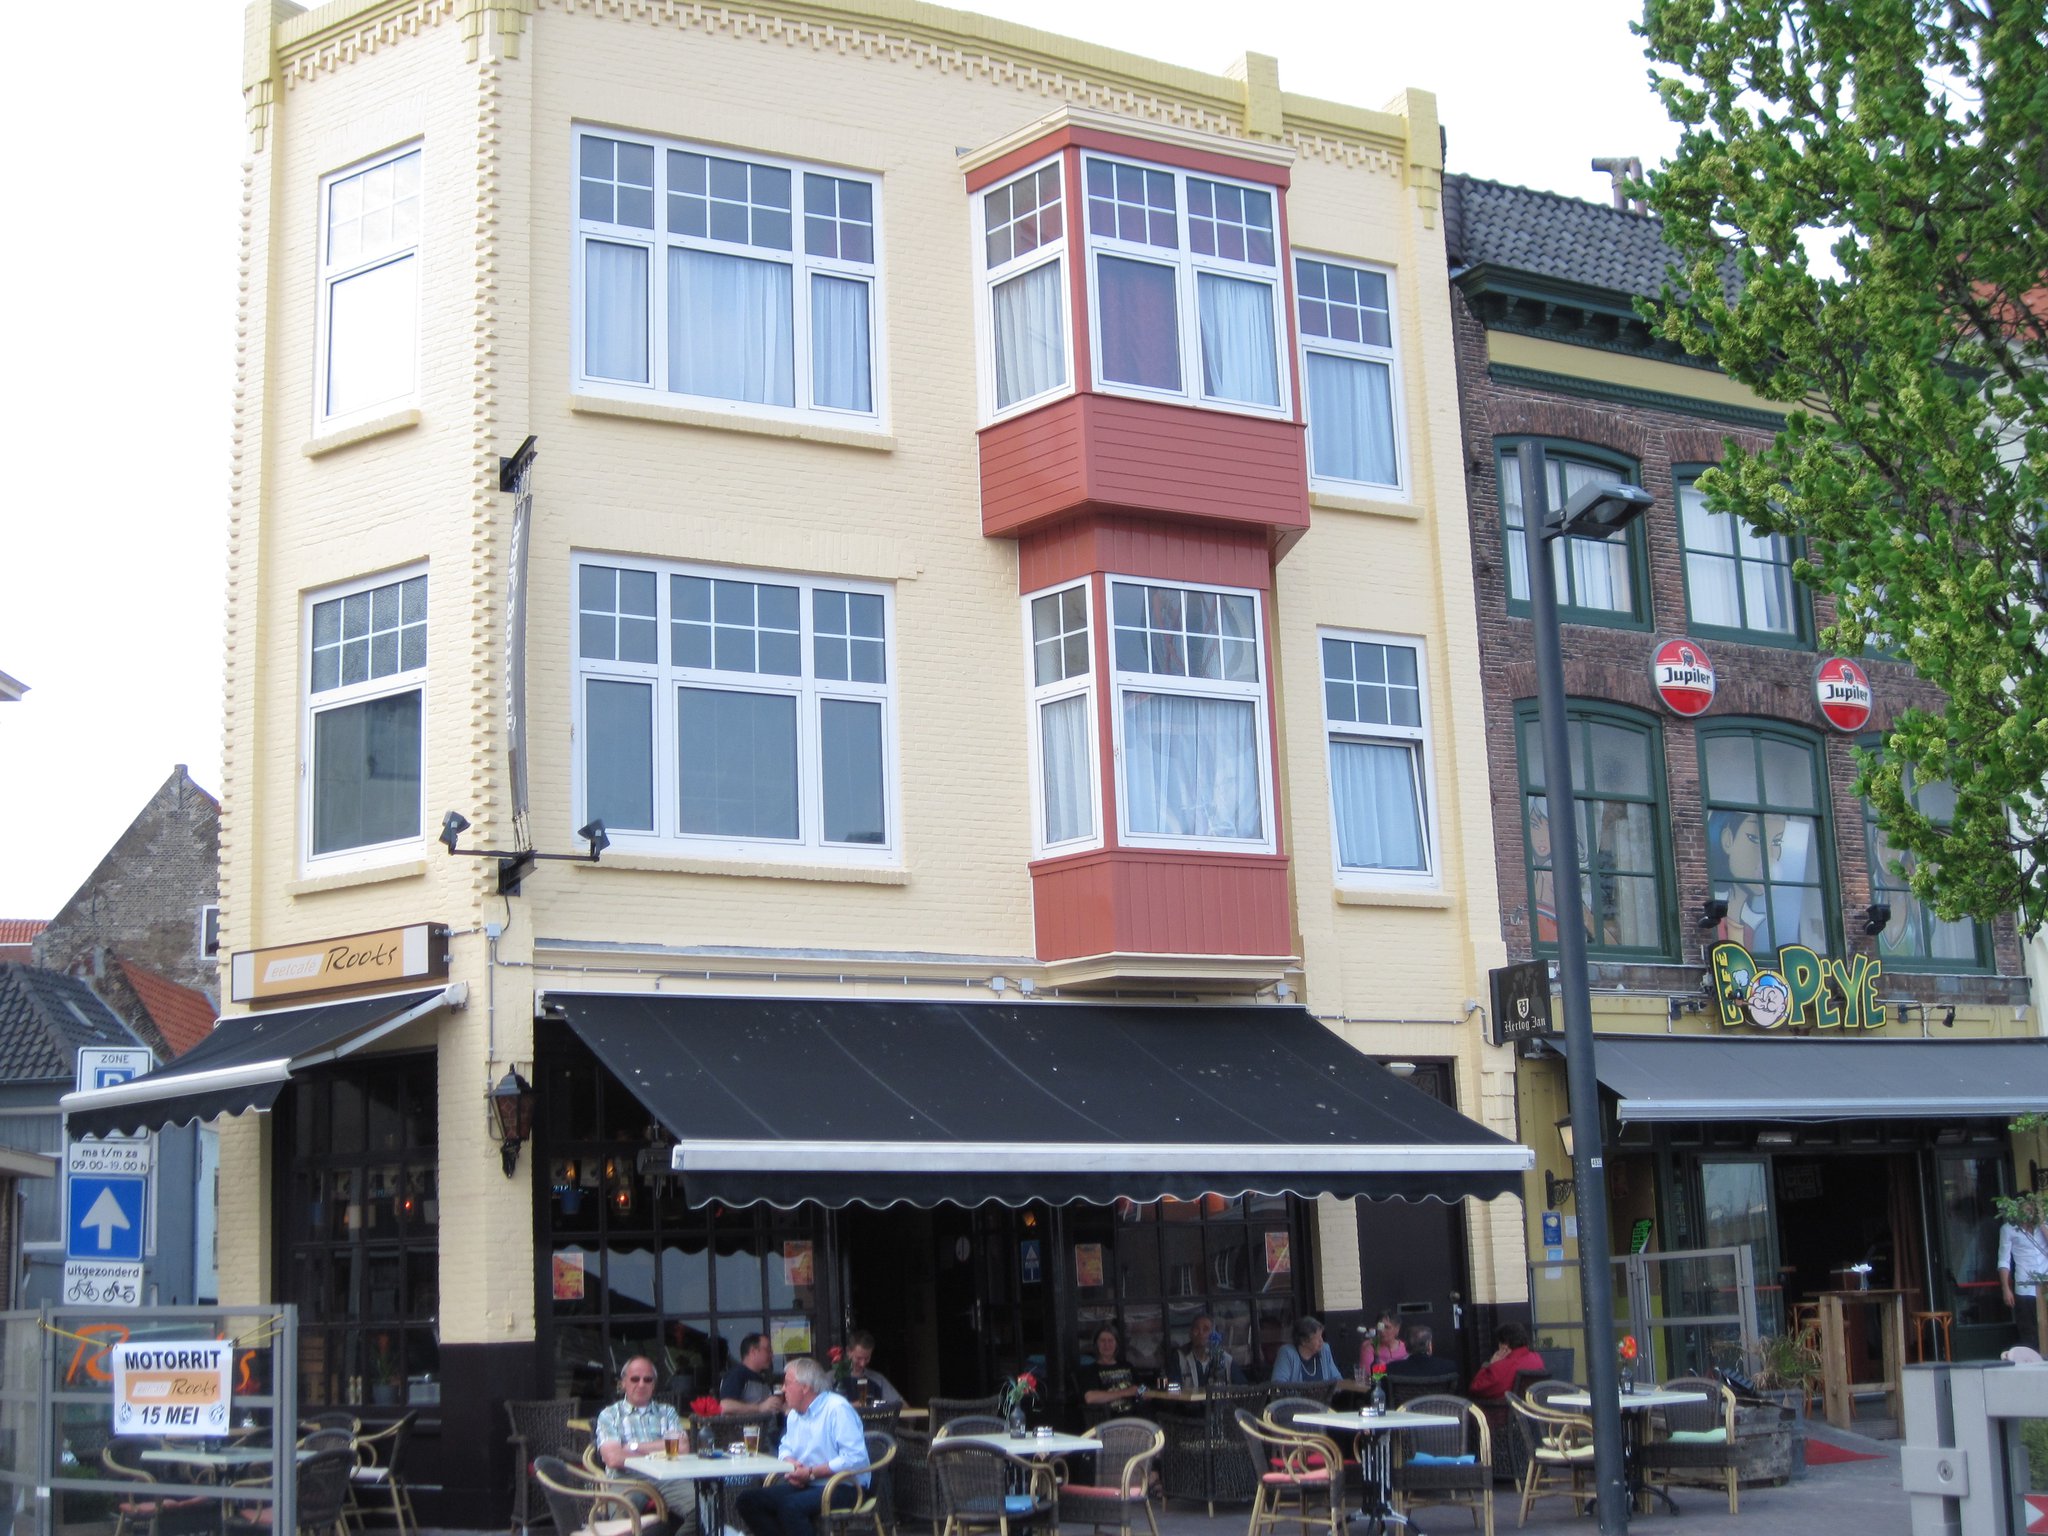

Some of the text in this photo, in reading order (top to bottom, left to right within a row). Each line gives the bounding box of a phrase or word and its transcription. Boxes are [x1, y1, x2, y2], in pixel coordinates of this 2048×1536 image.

[1663, 667, 1711, 686] Jupiler
[1825, 684, 1869, 702] Jupiler
[325, 943, 398, 973] Roots
[1504, 1015, 1546, 1033] Hertog Jan
[101, 1053, 129, 1064] ZONE
[82, 1147, 138, 1158] ma t/m za
[71, 1160, 147, 1171] 09.00-19.00 h
[67, 1264, 140, 1279] uitgezonderd
[125, 1350, 221, 1370] MOTORRIT
[171, 1378, 217, 1397] Roots
[141, 1406, 200, 1425] 15 MEI
